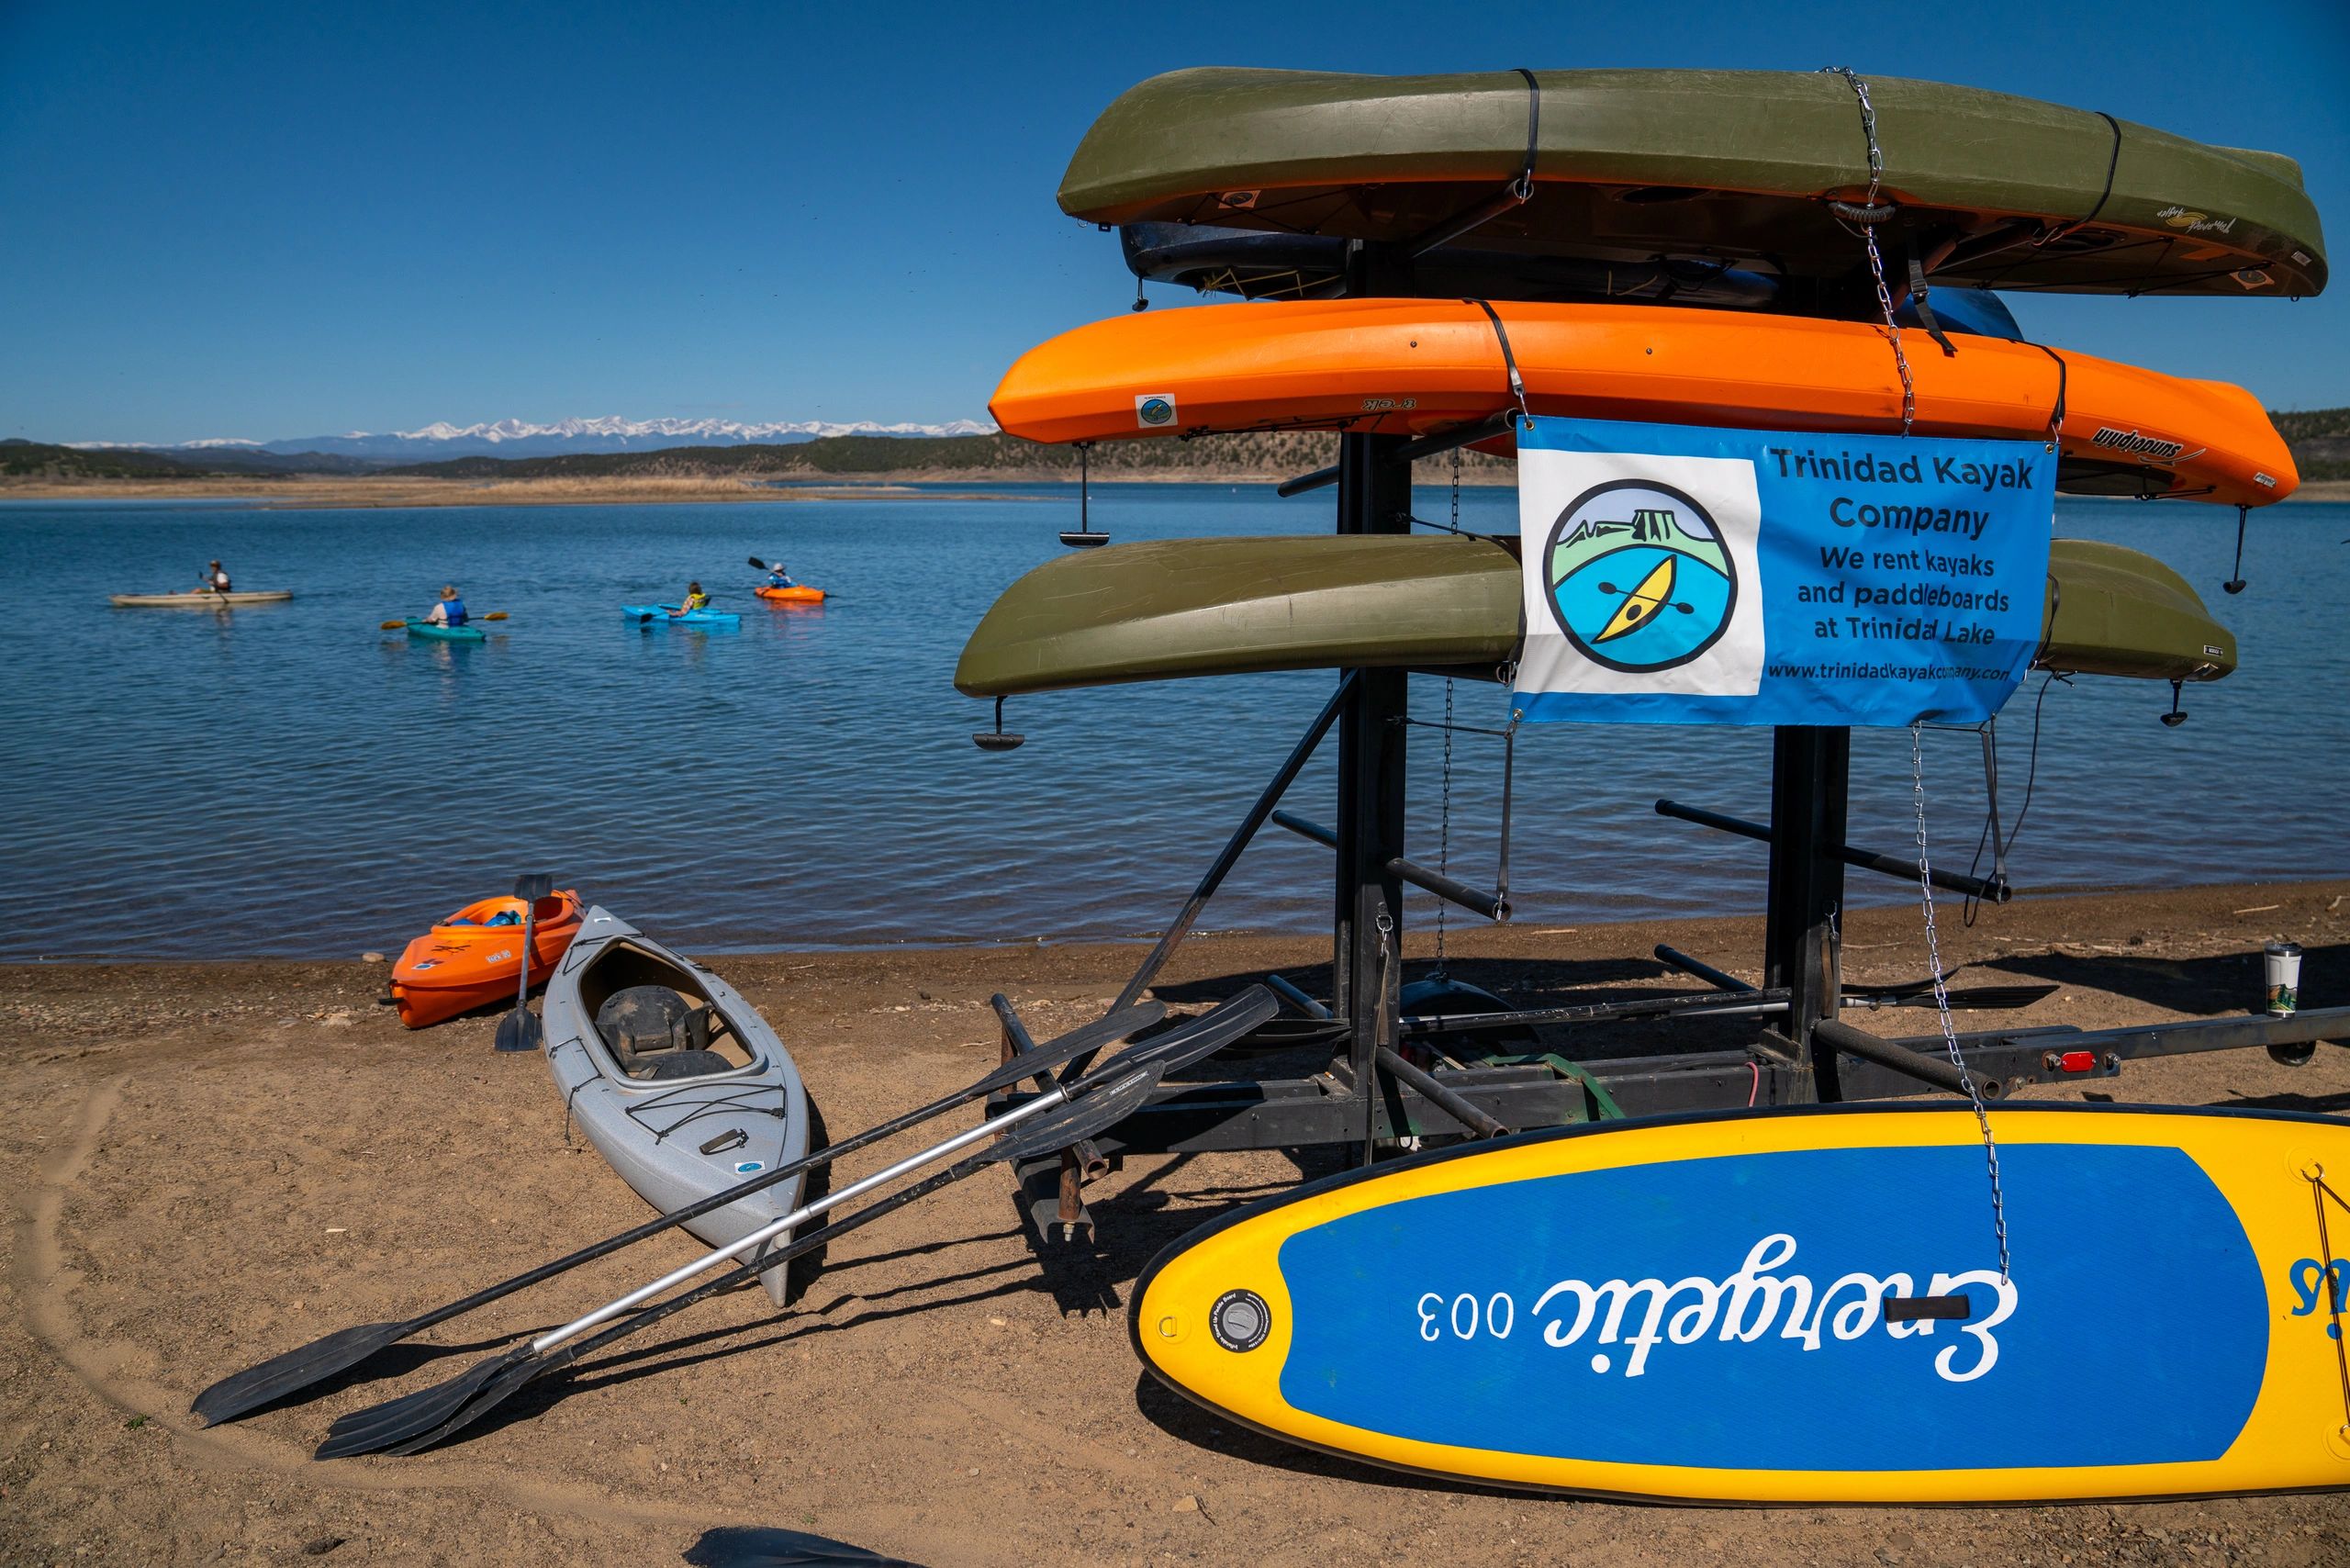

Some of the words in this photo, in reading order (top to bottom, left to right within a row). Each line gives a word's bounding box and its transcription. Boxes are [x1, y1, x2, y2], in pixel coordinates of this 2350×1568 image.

[1770, 448, 1923, 484] Trinidad
[1932, 457, 2034, 493] Kayak
[1830, 497, 1990, 541] Company
[1819, 546, 1864, 570] We
[1873, 550, 1921, 570] rent
[1925, 549, 1995, 577] kayaks
[1797, 580, 1845, 603] and
[1854, 582, 2009, 612] paddleboards
[1815, 617, 1839, 638] at
[1943, 621, 1996, 645] Lake
[1417, 1292, 1515, 1342] 003
[1531, 1233, 2019, 1383] Energetic
